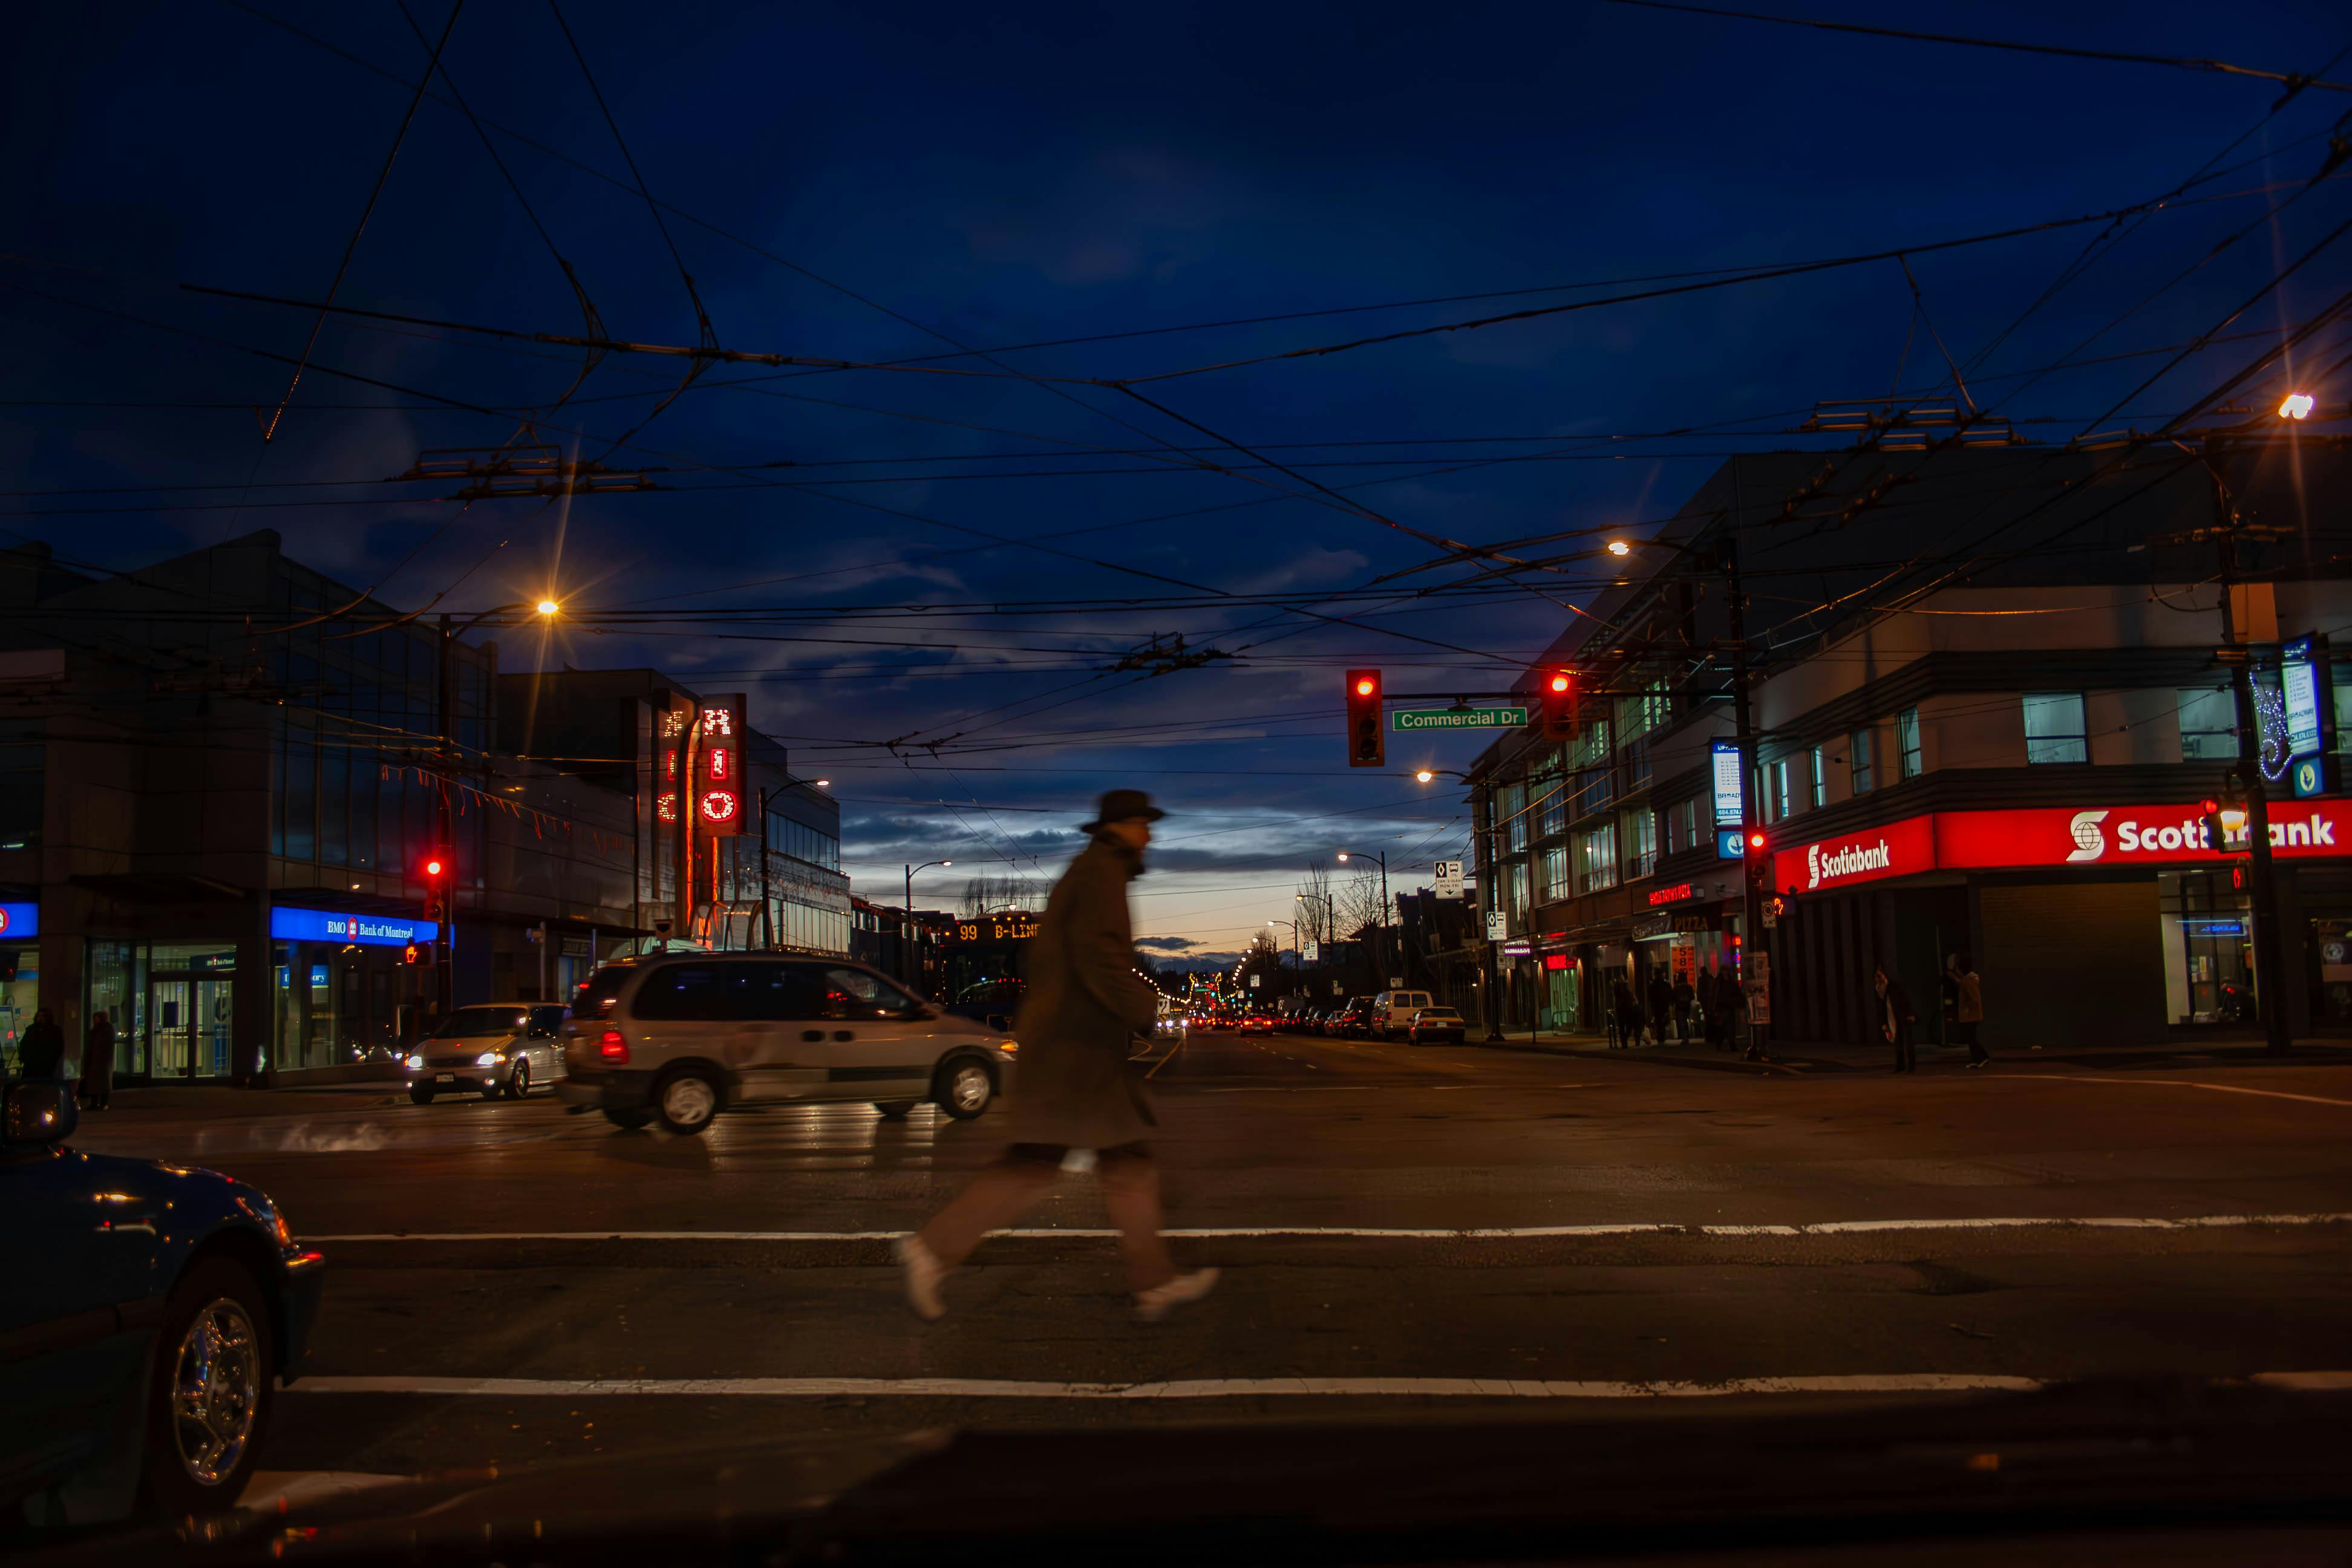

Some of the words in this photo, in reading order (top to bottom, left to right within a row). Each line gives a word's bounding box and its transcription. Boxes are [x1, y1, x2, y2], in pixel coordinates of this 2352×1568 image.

[1401, 711, 1494, 727] Commercial
[1501, 711, 1519, 724] Dr
[702, 708, 737, 822] RIO
[1821, 838, 1890, 879] Scotiabank
[327, 921, 346, 934] BMO
[359, 923, 377, 936] Bank
[377, 926, 385, 937] of
[385, 926, 413, 939] Montreal
[959, 924, 977, 940] 99
